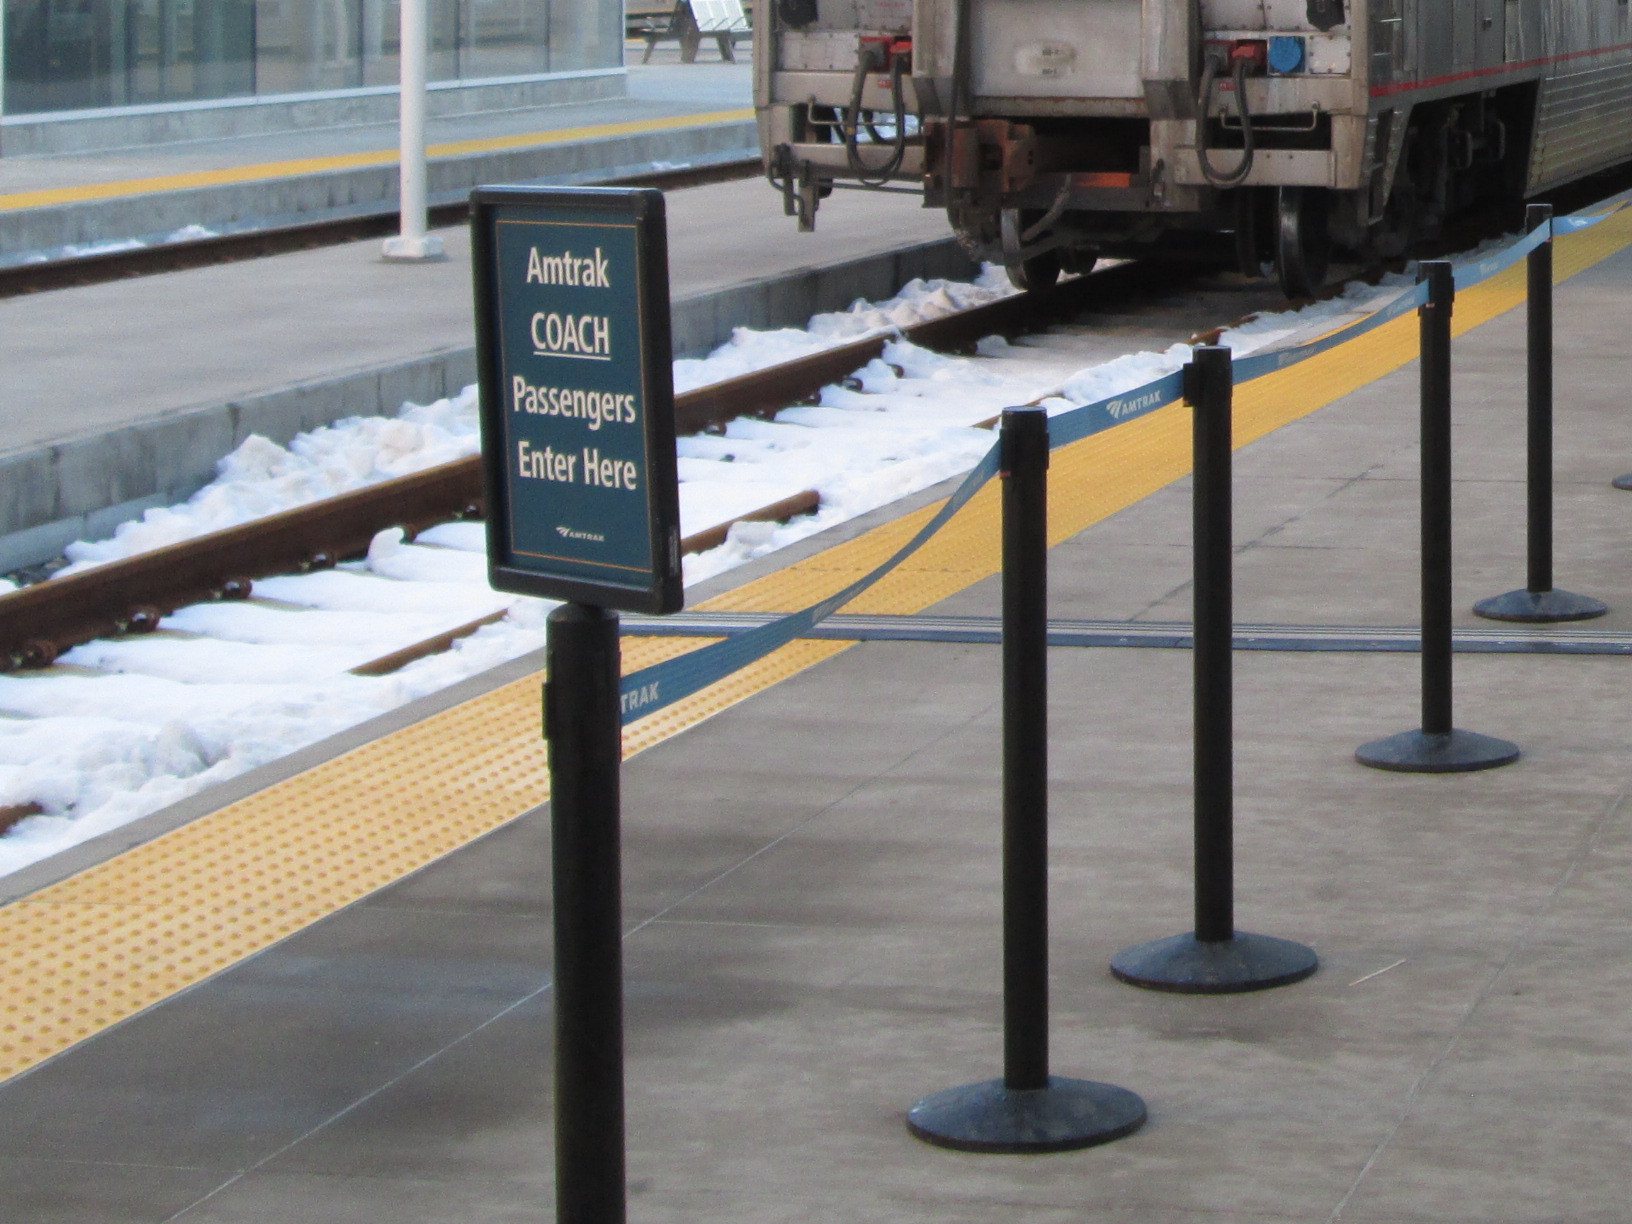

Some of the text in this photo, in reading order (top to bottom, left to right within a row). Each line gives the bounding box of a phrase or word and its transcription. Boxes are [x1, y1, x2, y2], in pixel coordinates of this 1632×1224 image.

[526, 246, 611, 288] Amtrak
[531, 312, 611, 356] COACH
[512, 376, 637, 431] Passengers
[1121, 390, 1162, 416] AMTRAK
[518, 440, 637, 491] Enter Here
[569, 531, 605, 542] AMTRAK
